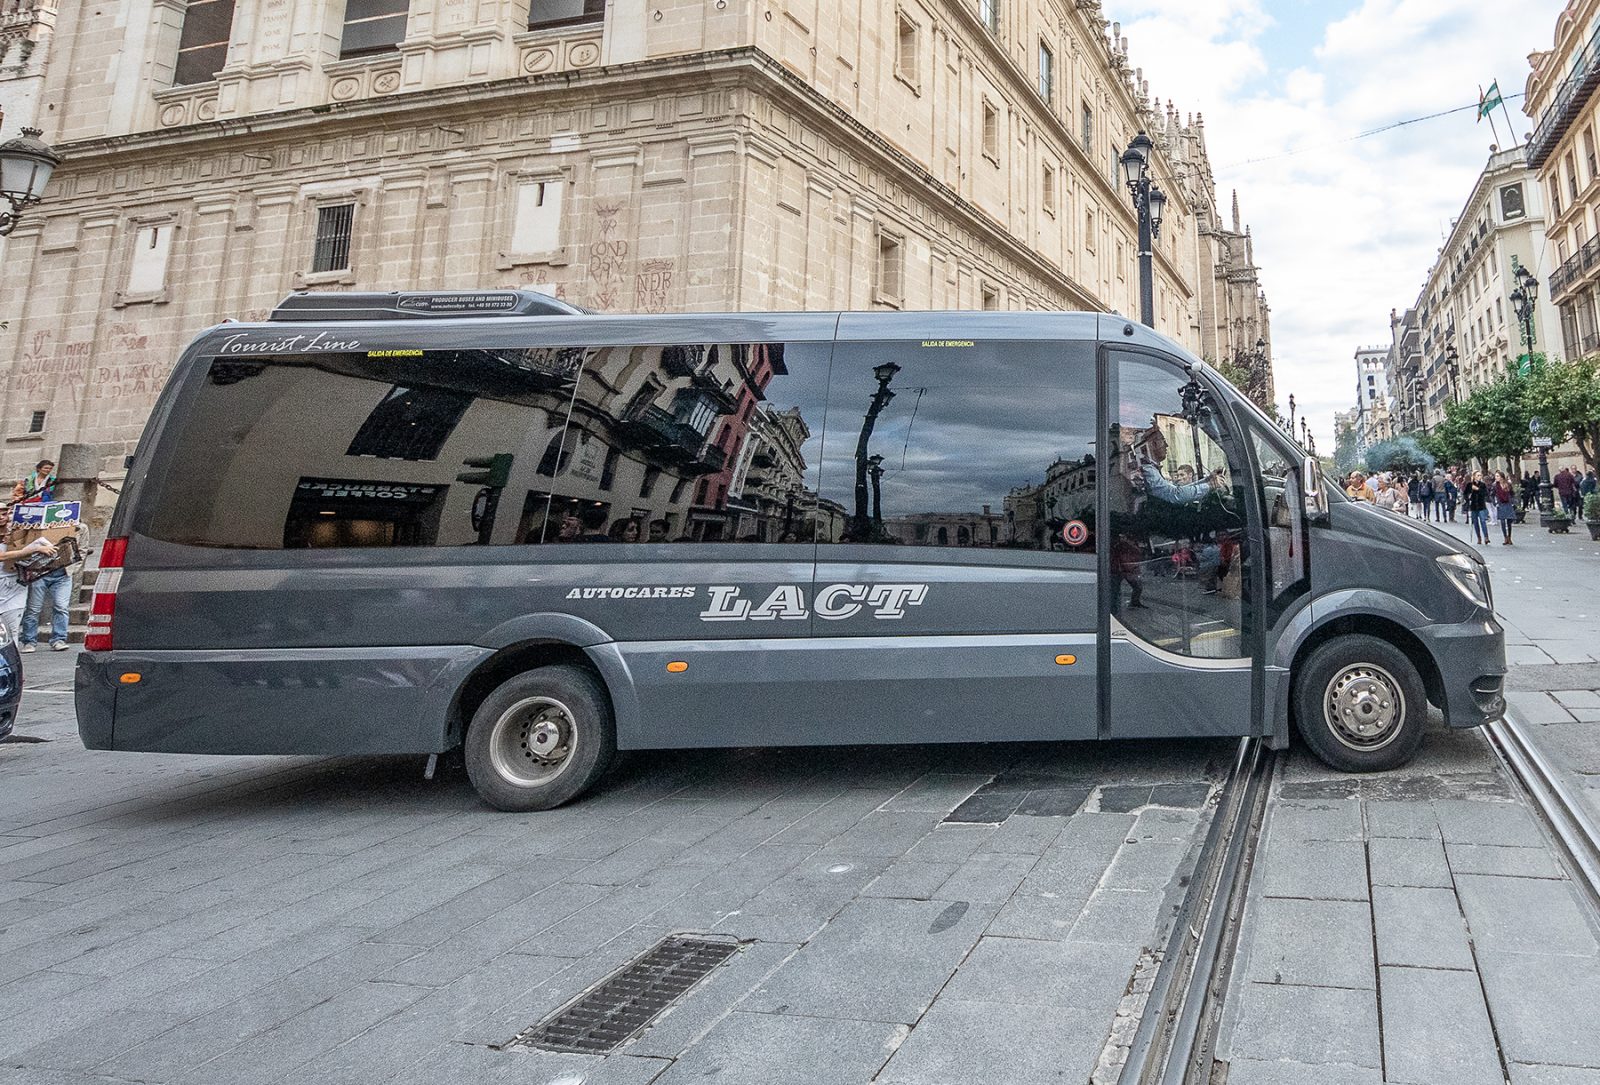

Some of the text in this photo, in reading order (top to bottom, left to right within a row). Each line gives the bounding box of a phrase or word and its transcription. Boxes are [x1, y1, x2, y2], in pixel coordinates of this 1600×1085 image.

[220, 331, 361, 353] Tourist Line
[367, 350, 385, 358] SALIDA
[392, 349, 423, 357] EMERGENCIA
[565, 586, 696, 600] AUTOCARES
[700, 584, 930, 622] LACT
